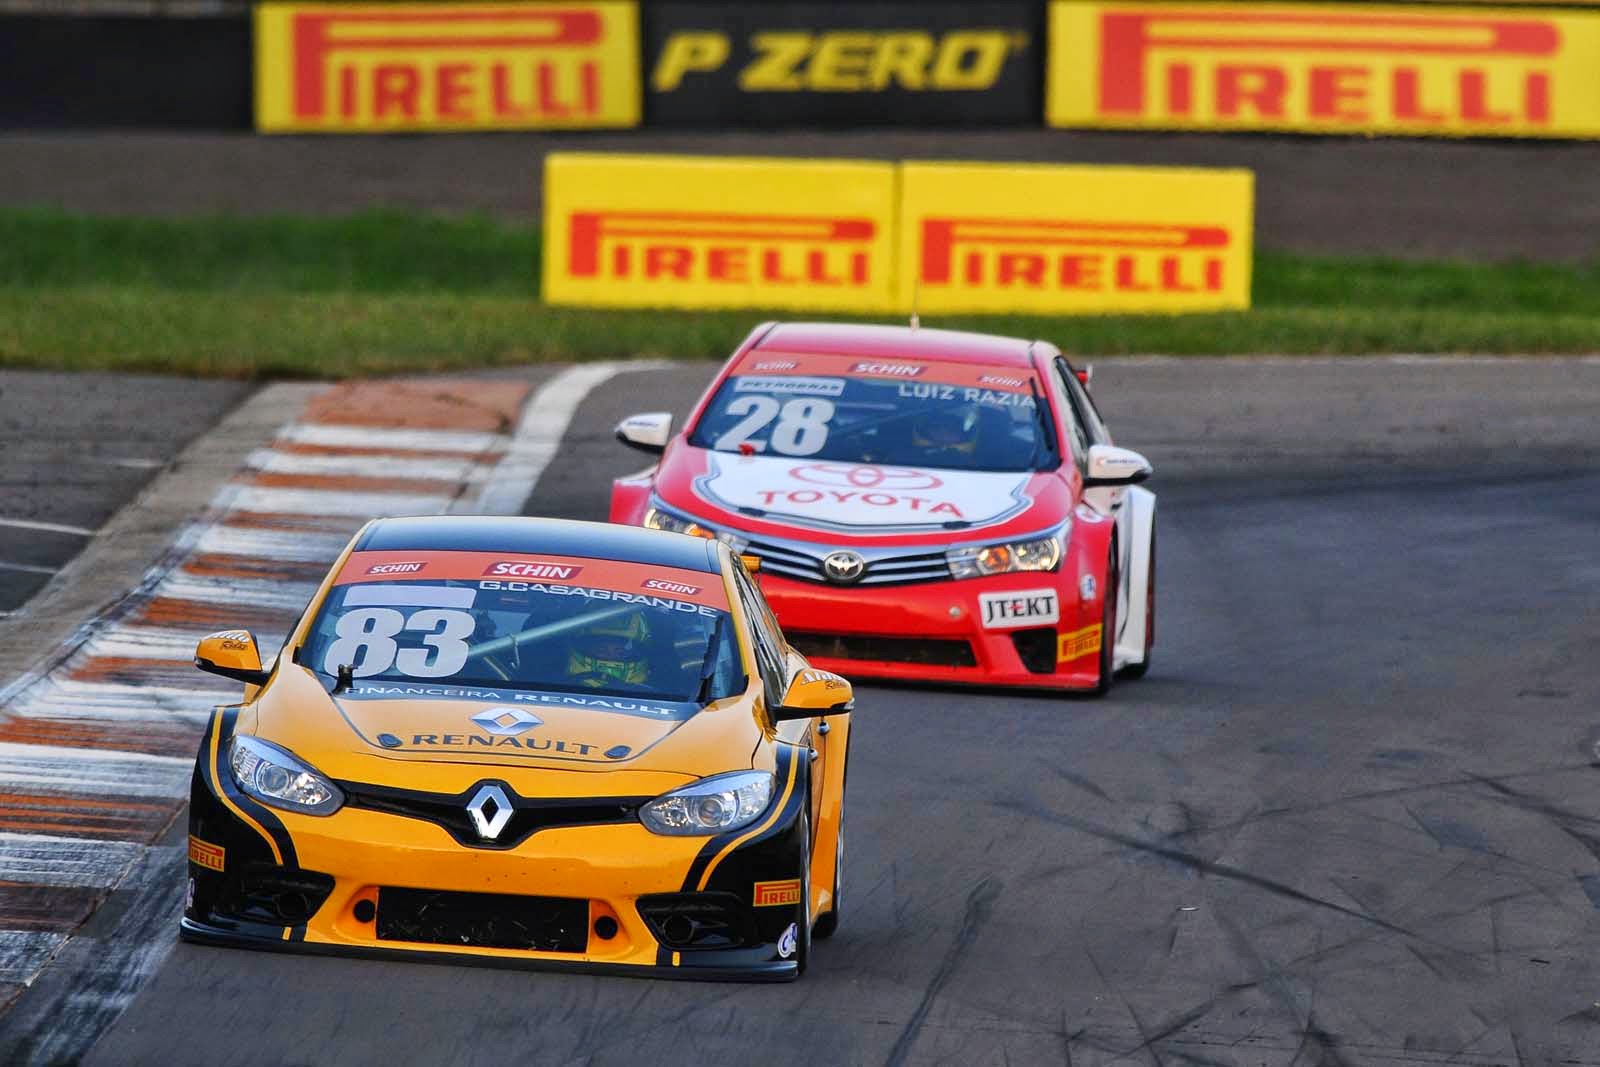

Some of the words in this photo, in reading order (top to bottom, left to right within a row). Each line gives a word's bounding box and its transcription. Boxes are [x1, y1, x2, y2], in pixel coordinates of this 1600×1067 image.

[293, 11, 603, 121] PIRELLI
[653, 32, 730, 92] P
[738, 31, 1010, 92] ZERO
[1098, 11, 1561, 125] PIRELLI
[568, 211, 877, 286] PIRELLI
[921, 218, 1231, 291] PIRELLI
[854, 362, 922, 376] SCHIN
[898, 383, 955, 400] LUIZ
[964, 388, 1037, 409] RAZIA
[714, 396, 836, 456] 28
[757, 490, 964, 518] TOYOTA
[370, 563, 421, 574] SCHIN
[493, 563, 572, 579] SCHIN
[479, 580, 717, 618] G.CASAGRANDE
[645, 580, 696, 595] SCHIN
[986, 596, 1055, 623] JTEKT
[324, 607, 477, 678] 83
[345, 687, 501, 699] FINANCEIRA
[514, 694, 678, 716] RENAULT
[412, 734, 600, 756] RENAULT
